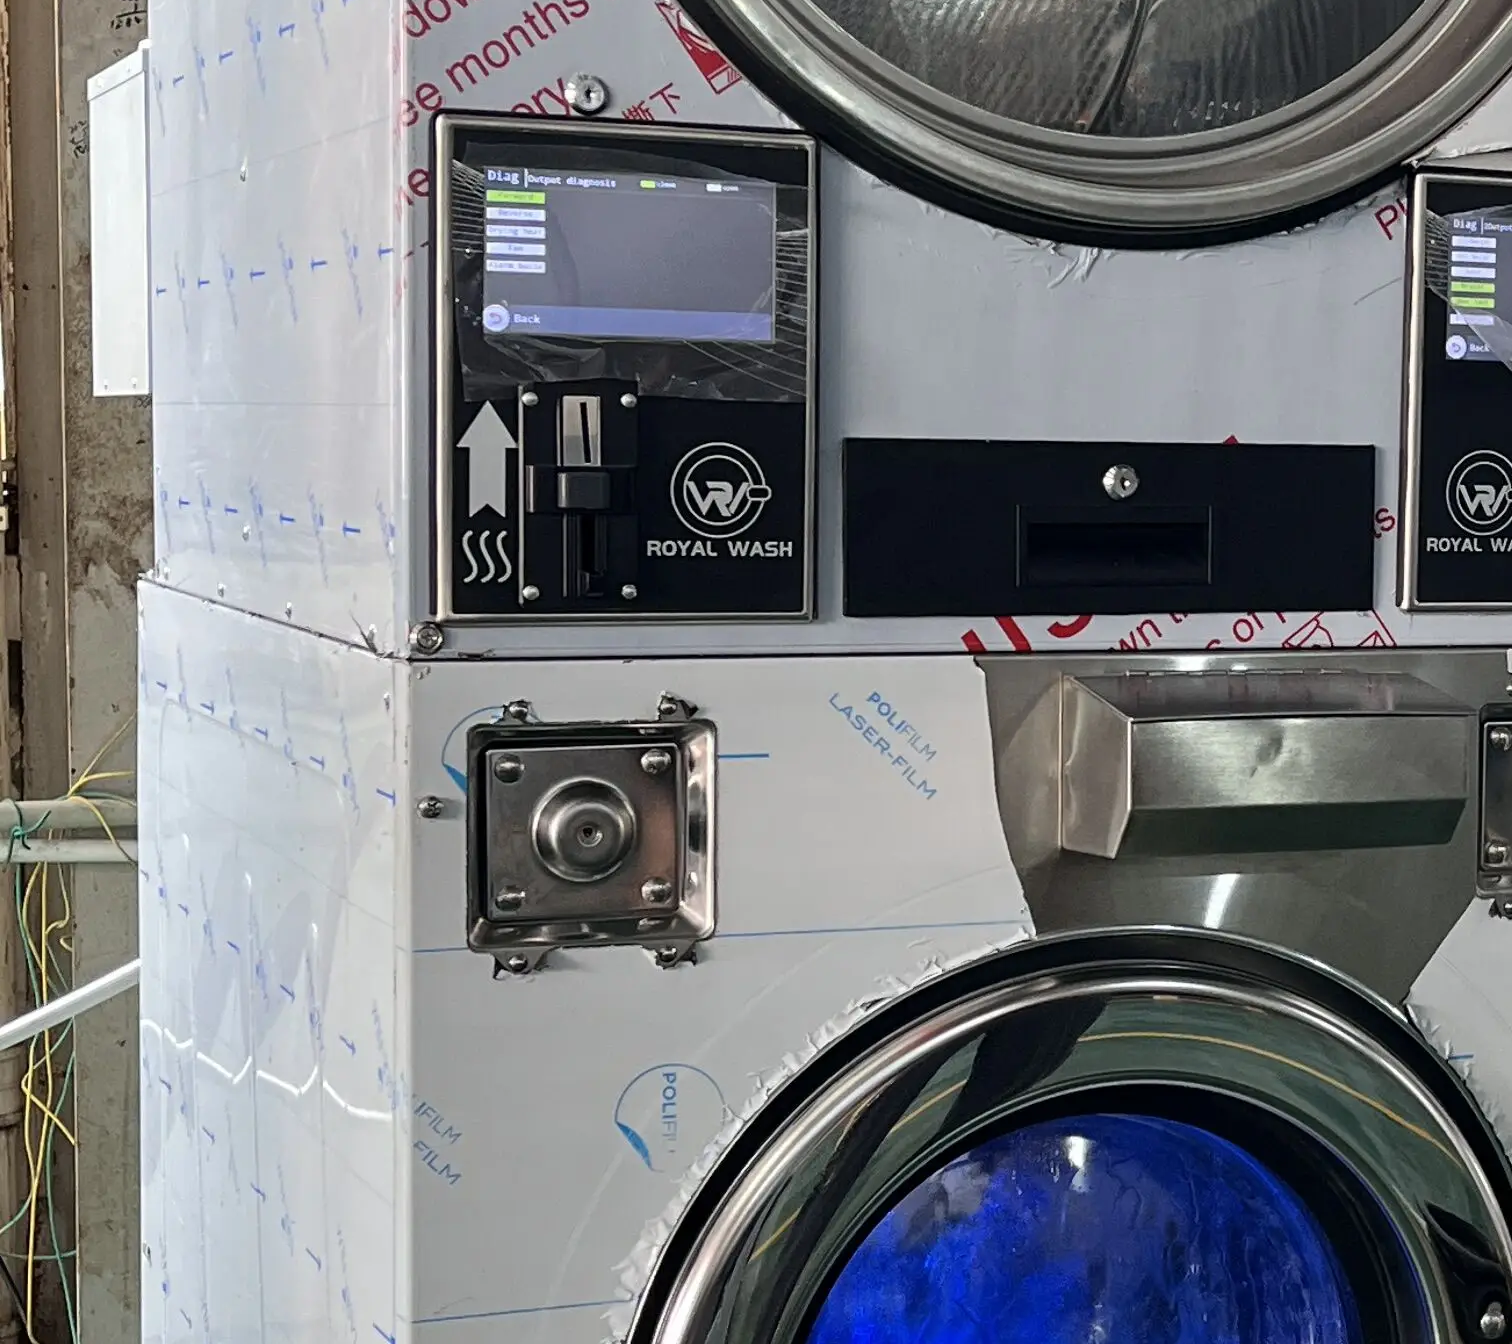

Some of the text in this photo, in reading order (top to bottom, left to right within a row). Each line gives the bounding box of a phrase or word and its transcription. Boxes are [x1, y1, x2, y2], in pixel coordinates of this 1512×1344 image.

[487, 169, 520, 186] Diag
[527, 174, 562, 186] Output
[566, 176, 617, 189] diagnosis
[1453, 218, 1478, 232] Diag
[512, 312, 542, 325] Back
[1469, 343, 1491, 354] Back
[646, 540, 793, 558] ROYAL WASH
[1426, 537, 1483, 553] ROYAL
[866, 691, 938, 763] POLIFILM
[828, 692, 938, 801] LASER-FILM
